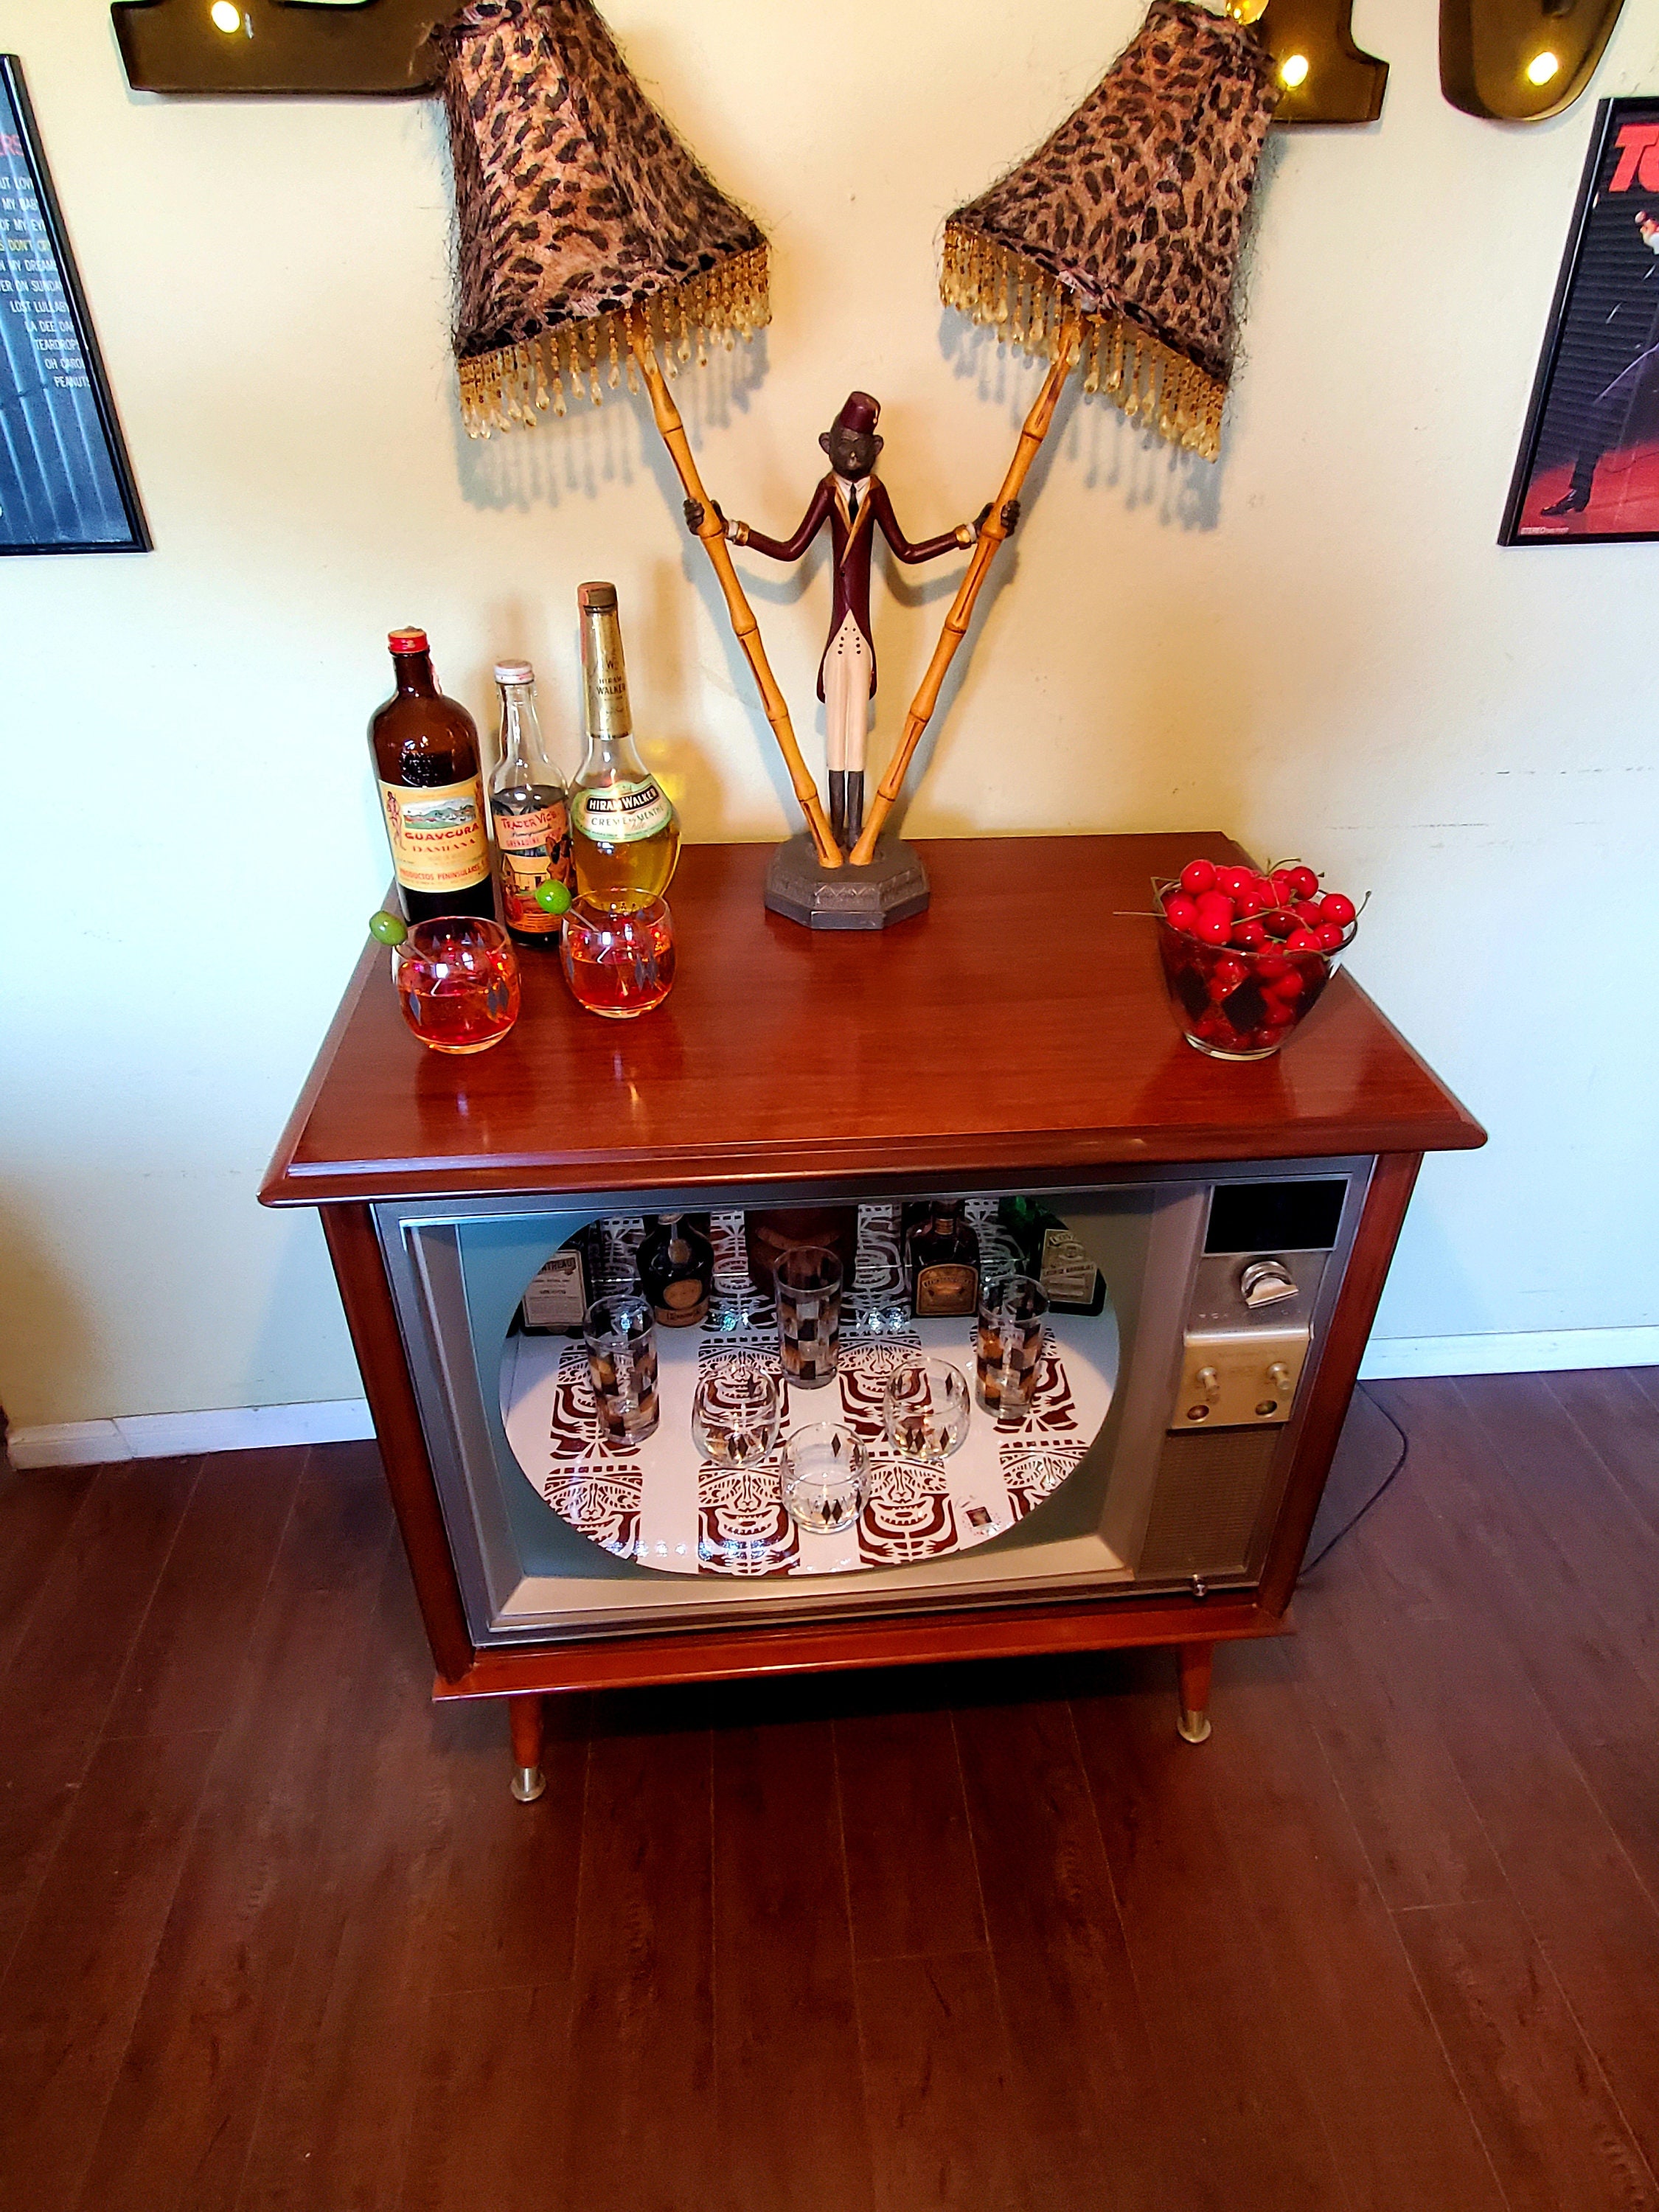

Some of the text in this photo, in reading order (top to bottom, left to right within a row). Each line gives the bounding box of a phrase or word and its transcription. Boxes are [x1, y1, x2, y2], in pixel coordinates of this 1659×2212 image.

[2, 198, 38, 211] MY BAB
[13, 218, 27, 232] MY
[10, 301, 31, 313] LOST
[24, 321, 38, 332] LA
[39, 321, 56, 332] DEE
[44, 358, 58, 369] OH
[589, 787, 658, 811] HIRAM WALKER
